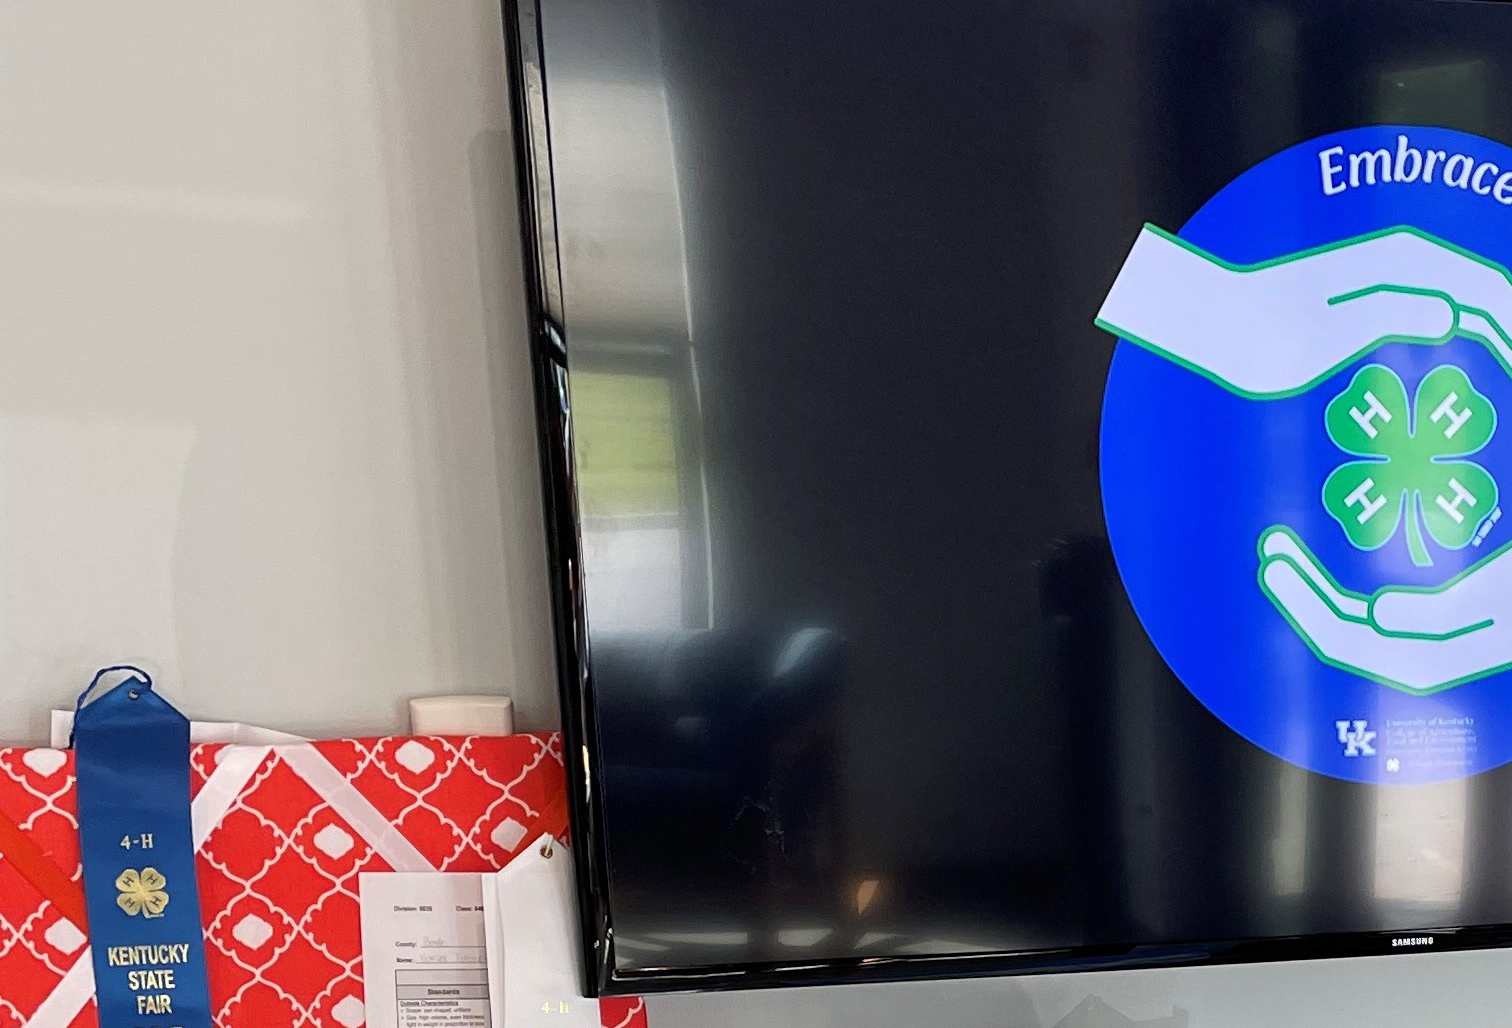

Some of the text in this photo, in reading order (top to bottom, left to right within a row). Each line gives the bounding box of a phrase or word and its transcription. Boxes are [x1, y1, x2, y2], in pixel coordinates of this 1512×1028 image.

[1349, 390, 1472, 439] H H
[1343, 477, 1477, 524] H H
[1336, 720, 1377, 757] UK
[121, 834, 153, 849] 4-H
[1391, 936, 1434, 947] SAMSUNG
[108, 944, 189, 967] KENTUCKY
[128, 970, 175, 990] STATE
[137, 995, 172, 1014] FAIR
[541, 999, 569, 1014] 4-H
